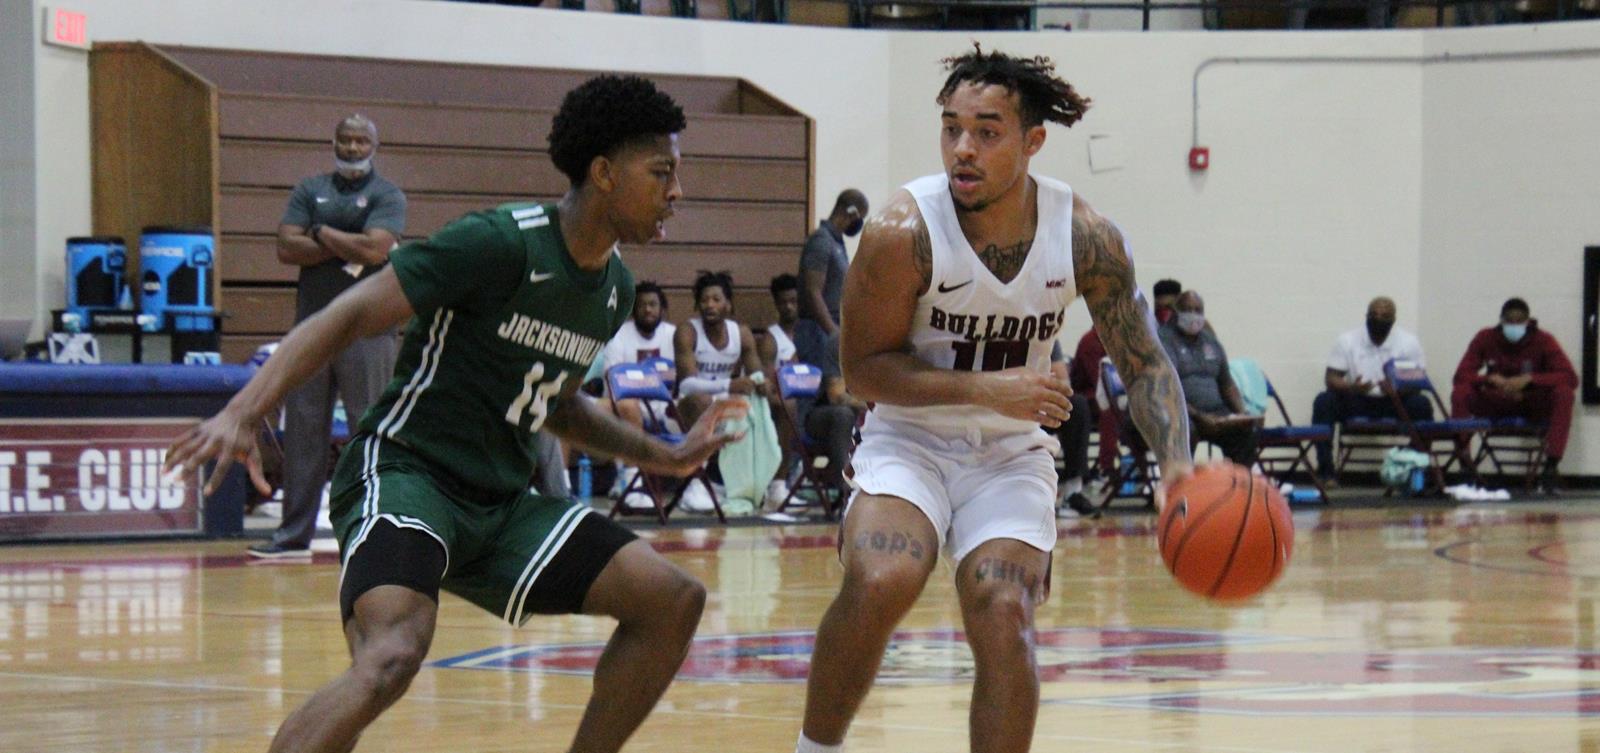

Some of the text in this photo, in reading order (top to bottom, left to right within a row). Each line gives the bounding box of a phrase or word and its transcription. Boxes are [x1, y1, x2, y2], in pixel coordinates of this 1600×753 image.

[55, 9, 87, 46] EXIT
[929, 306, 1066, 342] BULLDOGS
[504, 361, 568, 433] 14
[78, 448, 186, 512] CLUB
